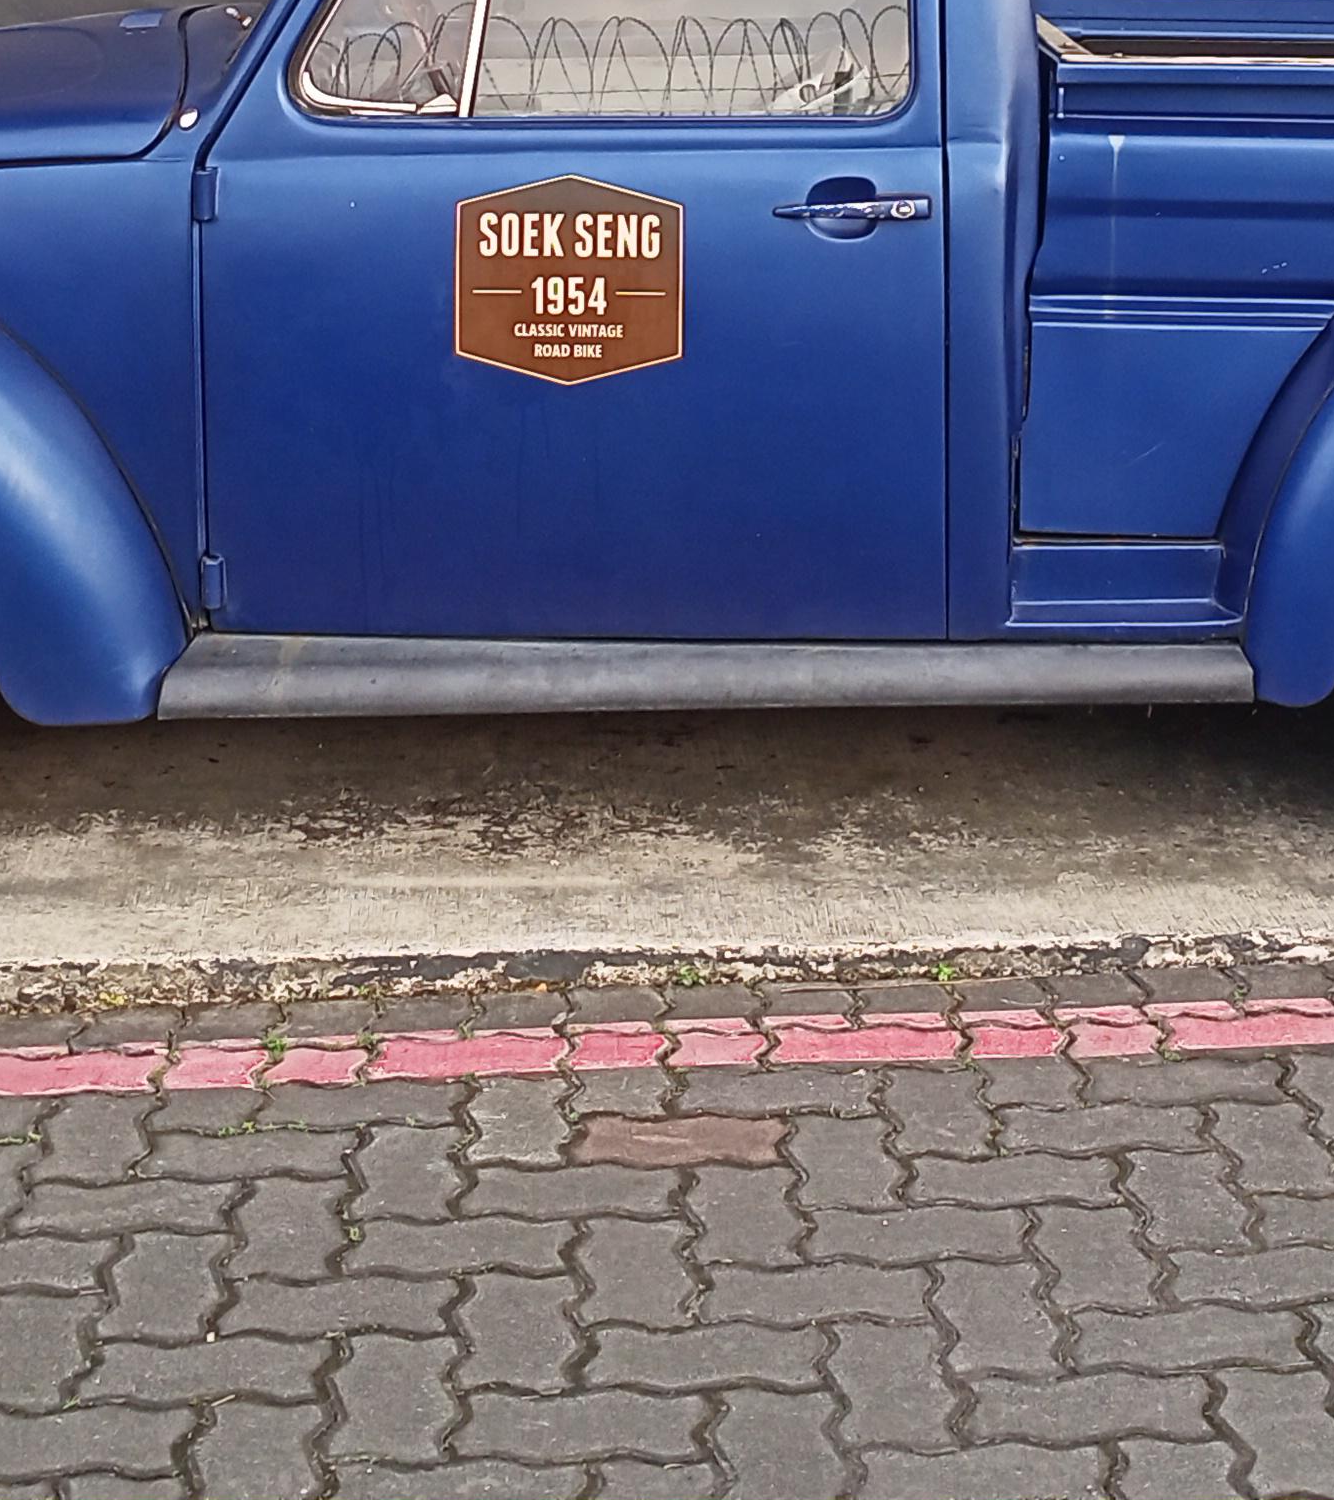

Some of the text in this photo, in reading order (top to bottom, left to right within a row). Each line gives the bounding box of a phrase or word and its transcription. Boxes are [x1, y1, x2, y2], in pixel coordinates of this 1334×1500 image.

[479, 211, 661, 259] SOEK SENG
[530, 276, 608, 316] 1954
[514, 323, 624, 339] CLASSIC VINTAGE
[533, 343, 603, 359] ROAD BIKE
